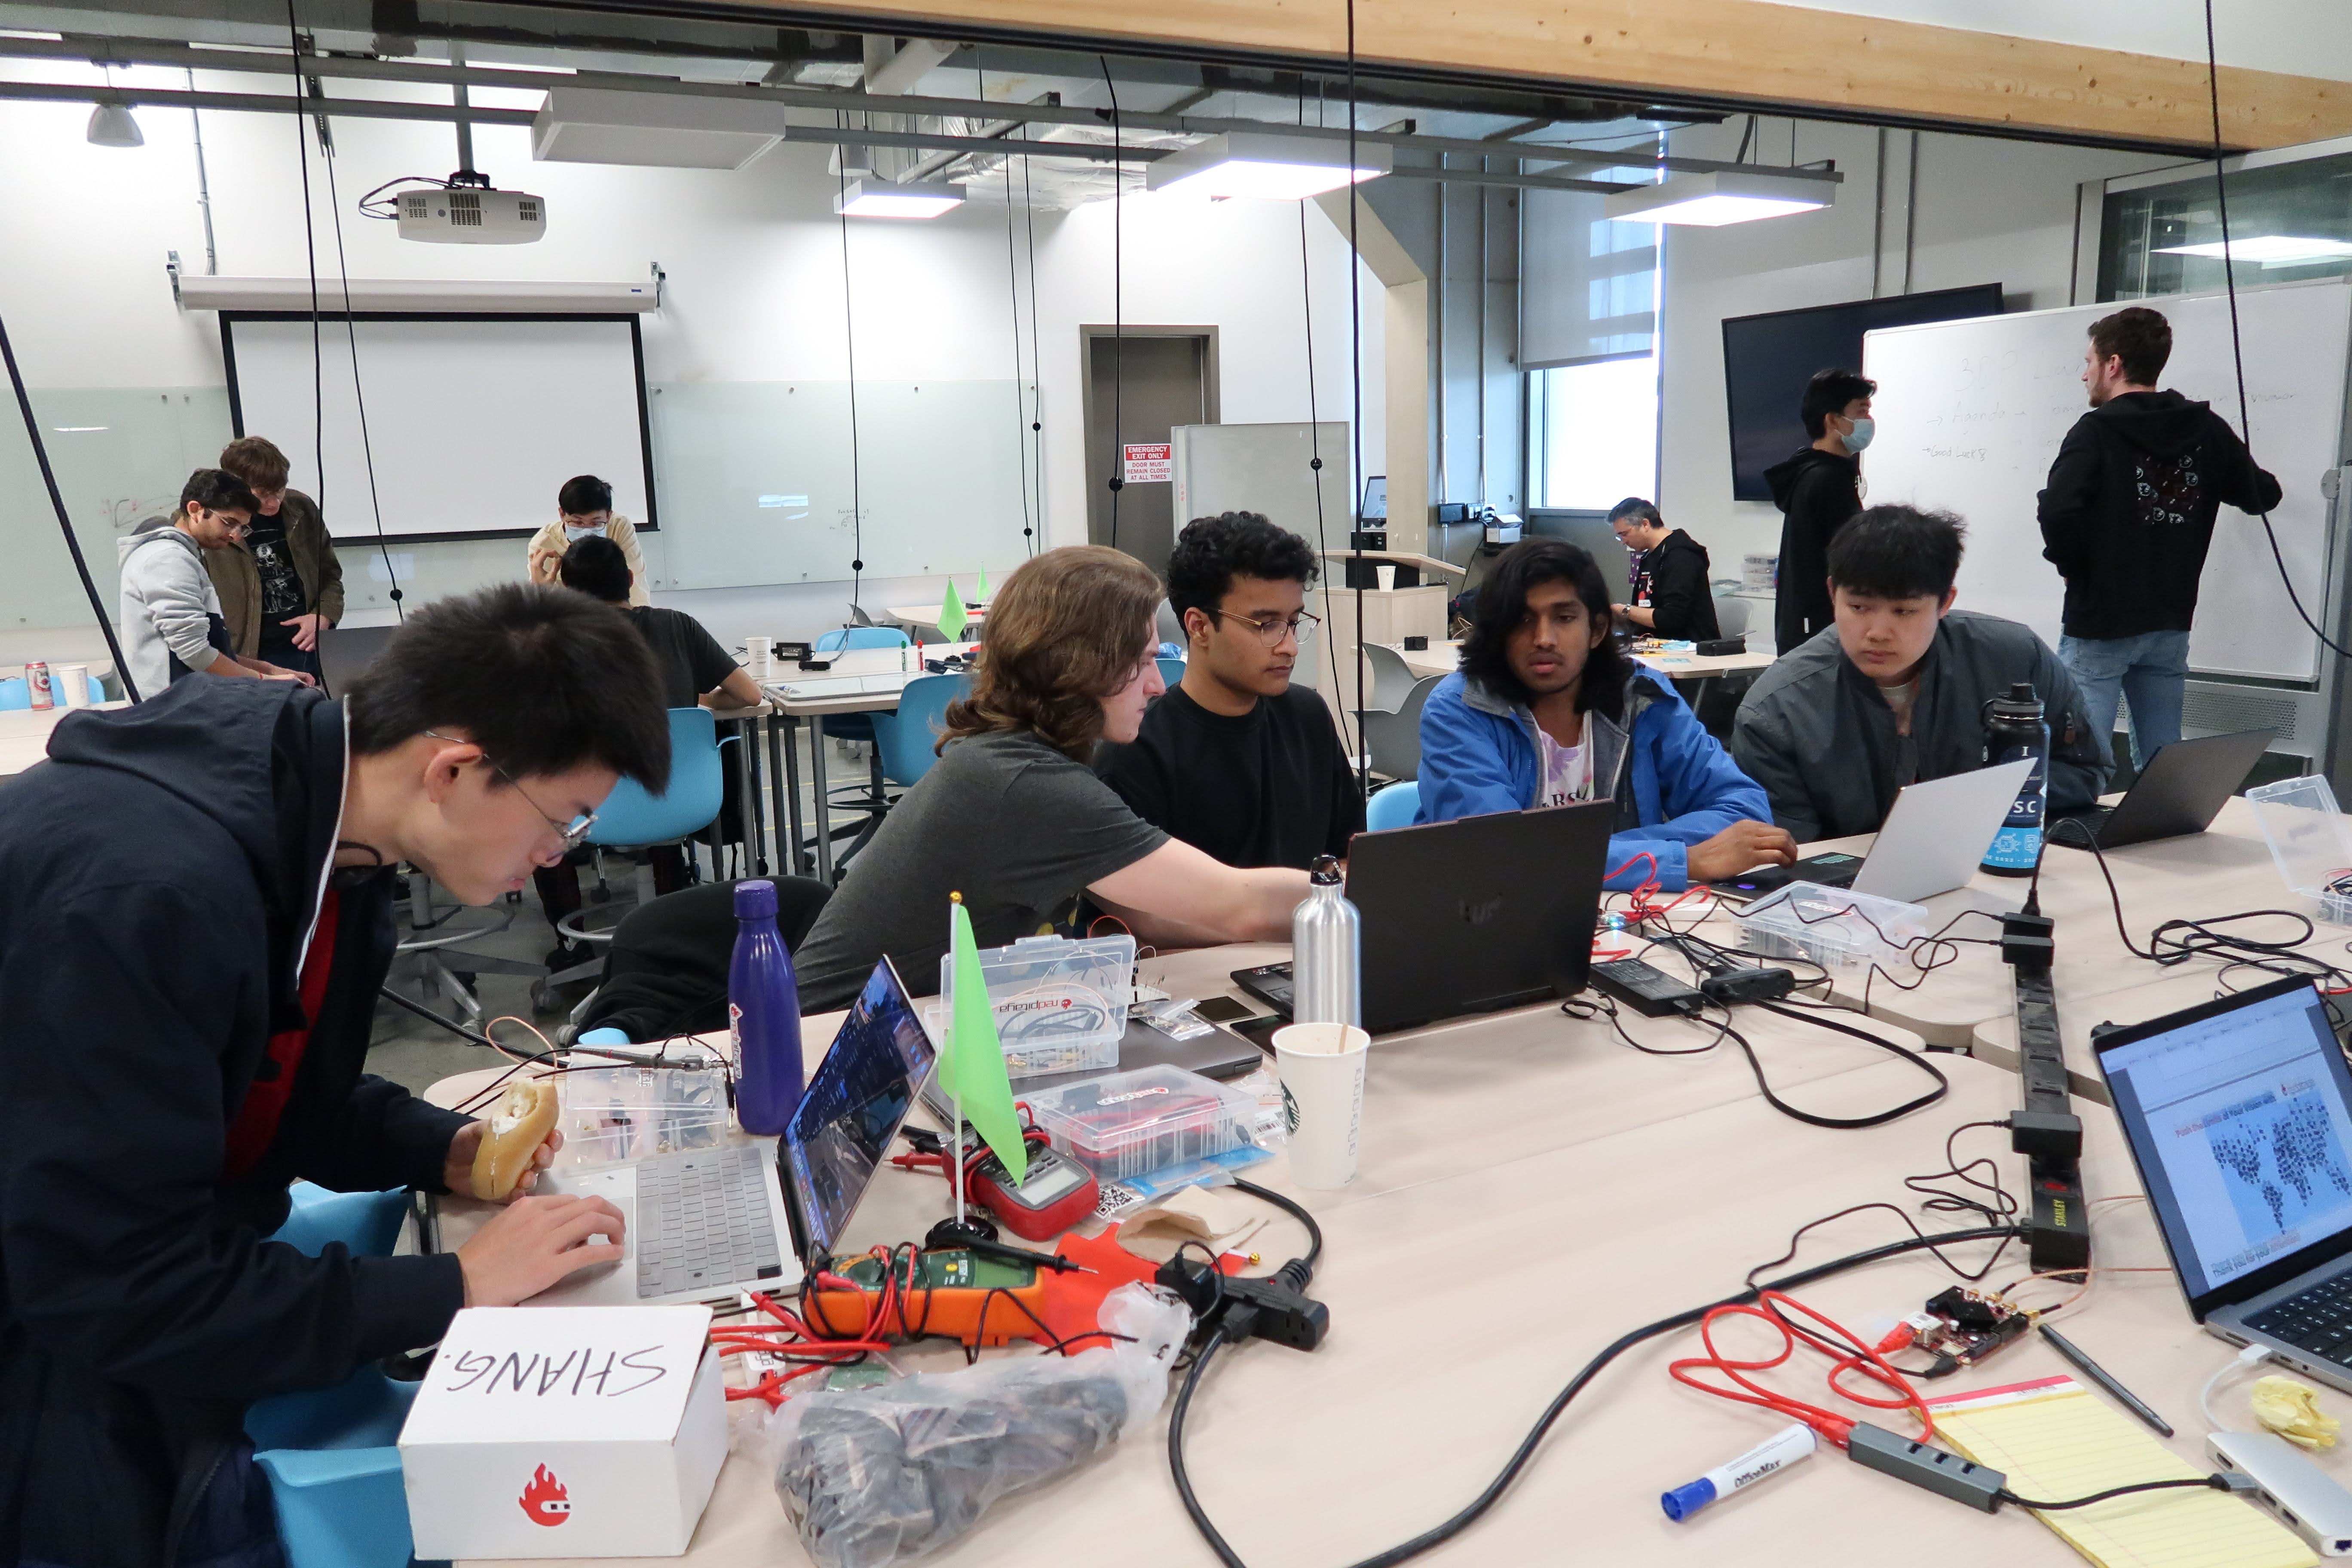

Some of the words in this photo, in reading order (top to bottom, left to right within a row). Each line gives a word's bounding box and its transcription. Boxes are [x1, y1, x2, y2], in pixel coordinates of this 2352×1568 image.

[1929, 444, 1952, 457] Good
[2013, 800, 2037, 814] SC
[998, 998, 1059, 1014] redpitaya
